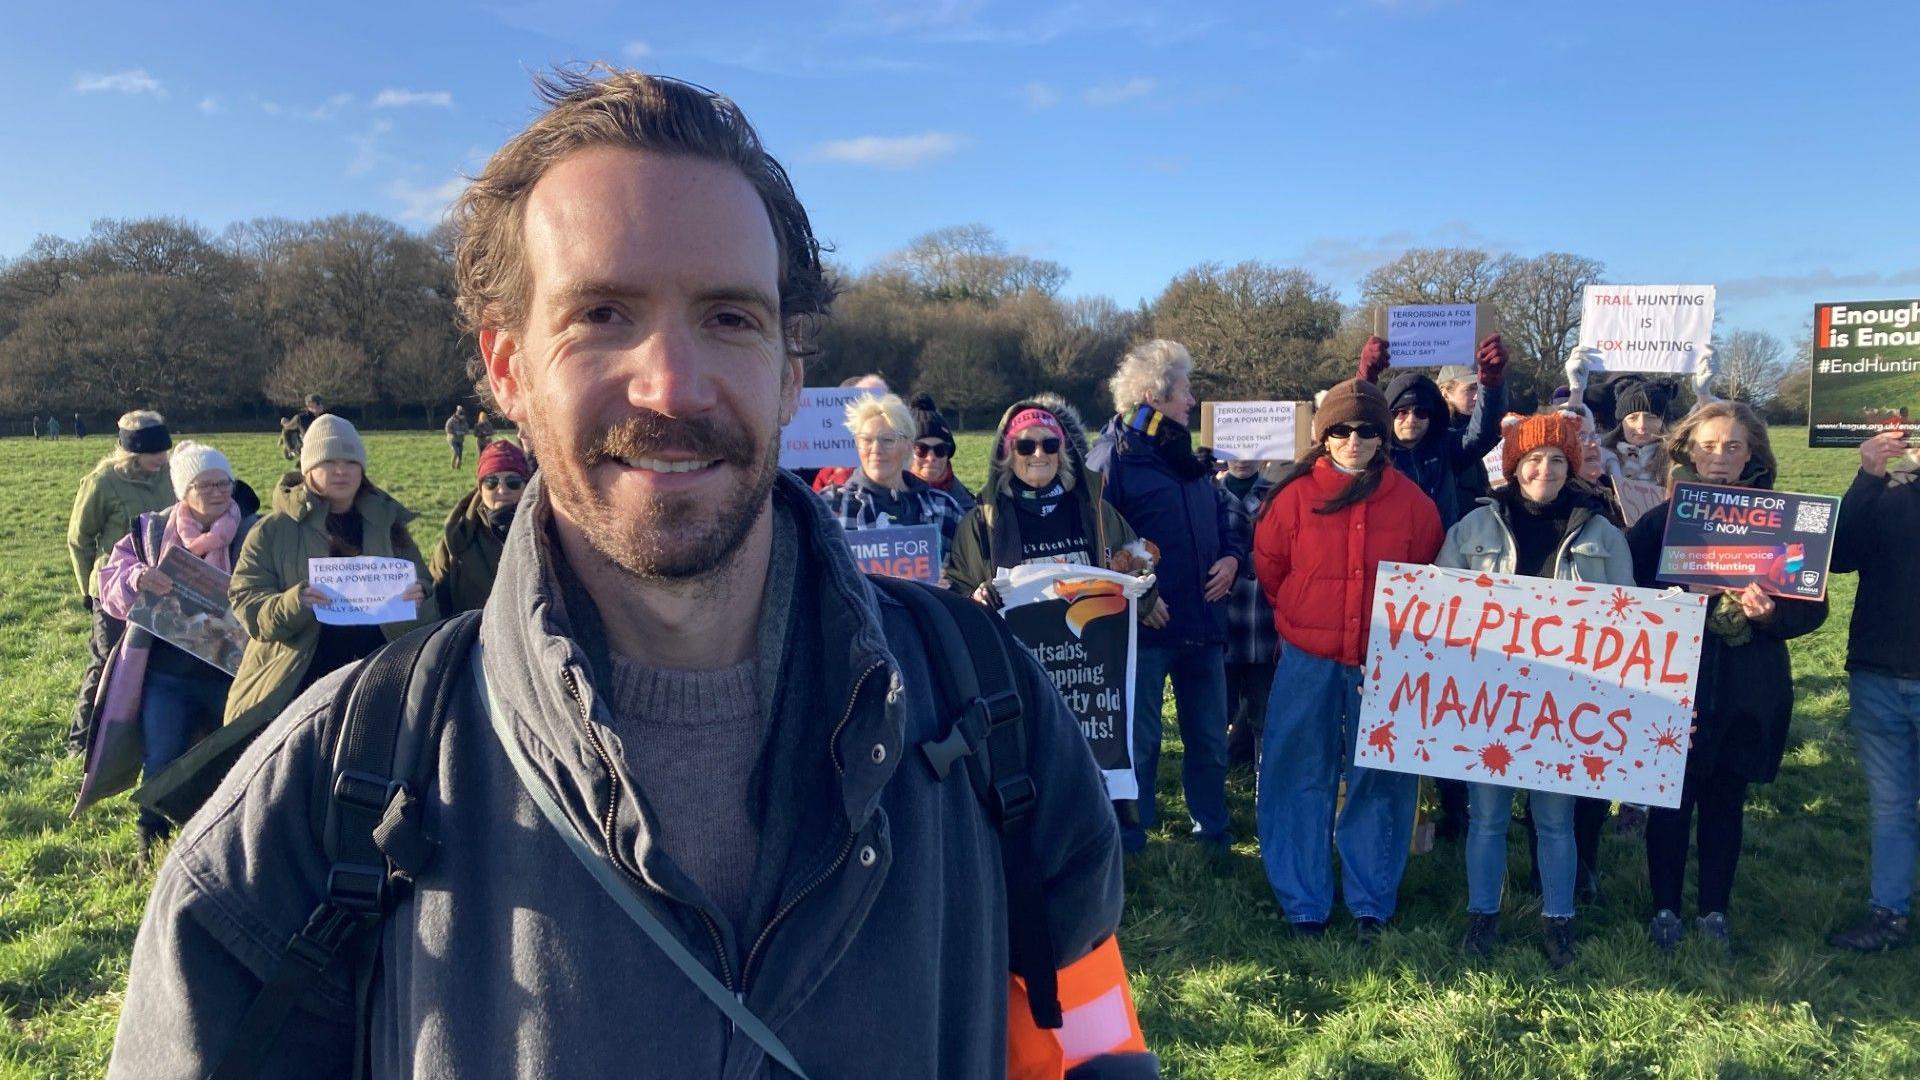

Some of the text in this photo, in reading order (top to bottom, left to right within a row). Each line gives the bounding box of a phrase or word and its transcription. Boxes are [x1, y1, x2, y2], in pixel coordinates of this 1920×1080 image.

[1595, 295, 1704, 306] TRAIL HUNTING
[1641, 318, 1652, 328] IS
[1830, 328, 1920, 348] is Enou
[1597, 340, 1693, 352] FOX HUNTING
[1818, 358, 1920, 373] #EndHuntin
[816, 396, 857, 408] HUNT
[822, 418, 832, 428] IS
[1816, 422, 1920, 432] www.league.org.uk/enou
[786, 440, 857, 450] FOX HUNTI
[1680, 488, 1785, 511] THE TIME FOR
[1676, 501, 1783, 529] CHANGE
[1703, 522, 1748, 536] IS NOW
[894, 540, 929, 556] FOR
[1668, 549, 1774, 564] We need your voice
[314, 563, 378, 572] TERRORISING
[858, 556, 929, 578] NGE
[1668, 560, 1756, 573] to #EndHunting
[315, 576, 334, 584] FOR
[346, 574, 381, 582] POWER
[384, 572, 409, 581] TRIP?
[1384, 594, 1689, 688] VULPICIDAL
[1029, 641, 1087, 662] tsabs,
[1096, 688, 1120, 711] old
[1389, 672, 1632, 756] MANIACS
[1080, 716, 1114, 740] nts!
